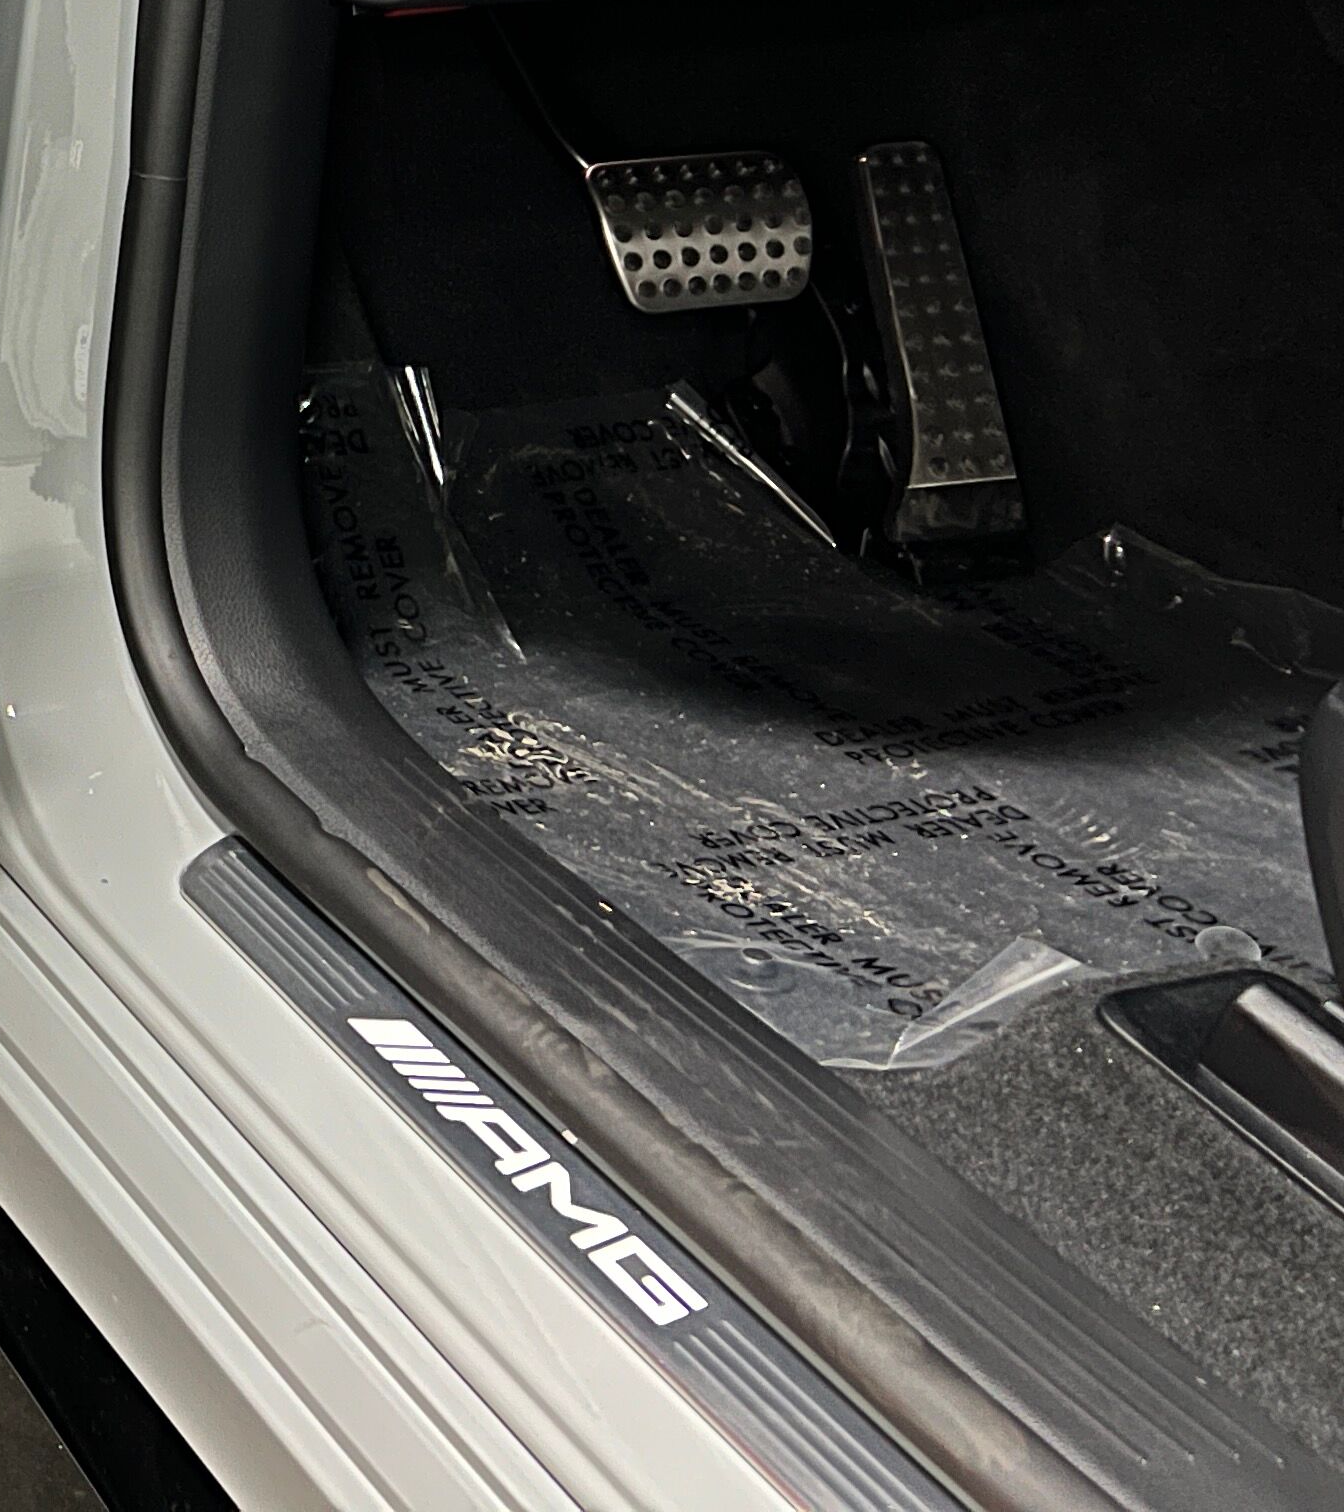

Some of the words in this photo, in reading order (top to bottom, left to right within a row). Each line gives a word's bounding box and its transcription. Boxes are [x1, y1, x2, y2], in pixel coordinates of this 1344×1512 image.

[319, 464, 381, 600] REMOVE
[375, 535, 429, 643] COVER
[814, 714, 933, 746] DEALER
[490, 797, 559, 816] VER
[803, 784, 999, 834] PROTECTIVE
[903, 803, 1034, 840] DEALER
[687, 820, 801, 850] COVER
[807, 829, 896, 858] MUST
[1096, 861, 1220, 926] COVER
